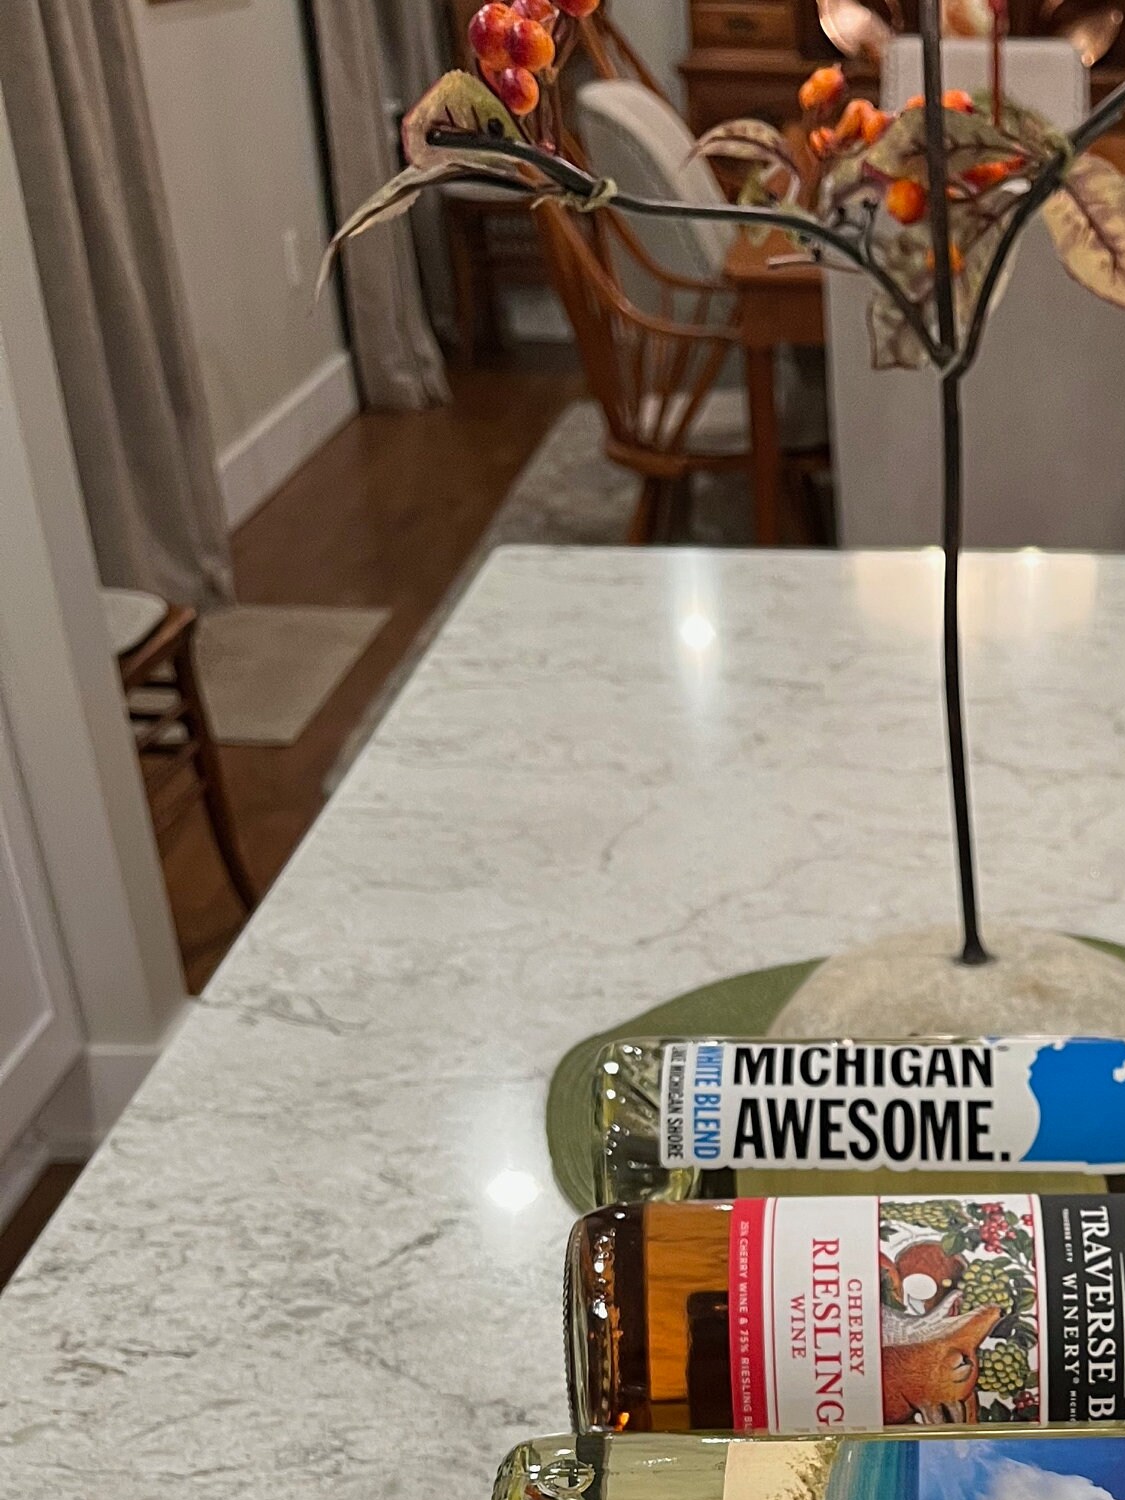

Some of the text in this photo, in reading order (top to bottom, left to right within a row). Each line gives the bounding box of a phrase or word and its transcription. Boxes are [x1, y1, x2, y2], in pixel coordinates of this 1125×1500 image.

[733, 1047, 994, 1088] MICHIGAN
[693, 1046, 724, 1160] WHITE BLEND
[733, 1098, 1011, 1162] AWESOME.
[667, 1117, 684, 1159] SHORE
[739, 1238, 749, 1278] CHERRY
[739, 1282, 748, 1313] WINE
[1080, 1206, 1116, 1384] TRAVERSE
[740, 1329, 750, 1353] 75%
[790, 1294, 806, 1359] WINE
[812, 1238, 845, 1426] RIESLING
[847, 1278, 865, 1376] CHERRY
[741, 1357, 753, 1412] RIESLING
